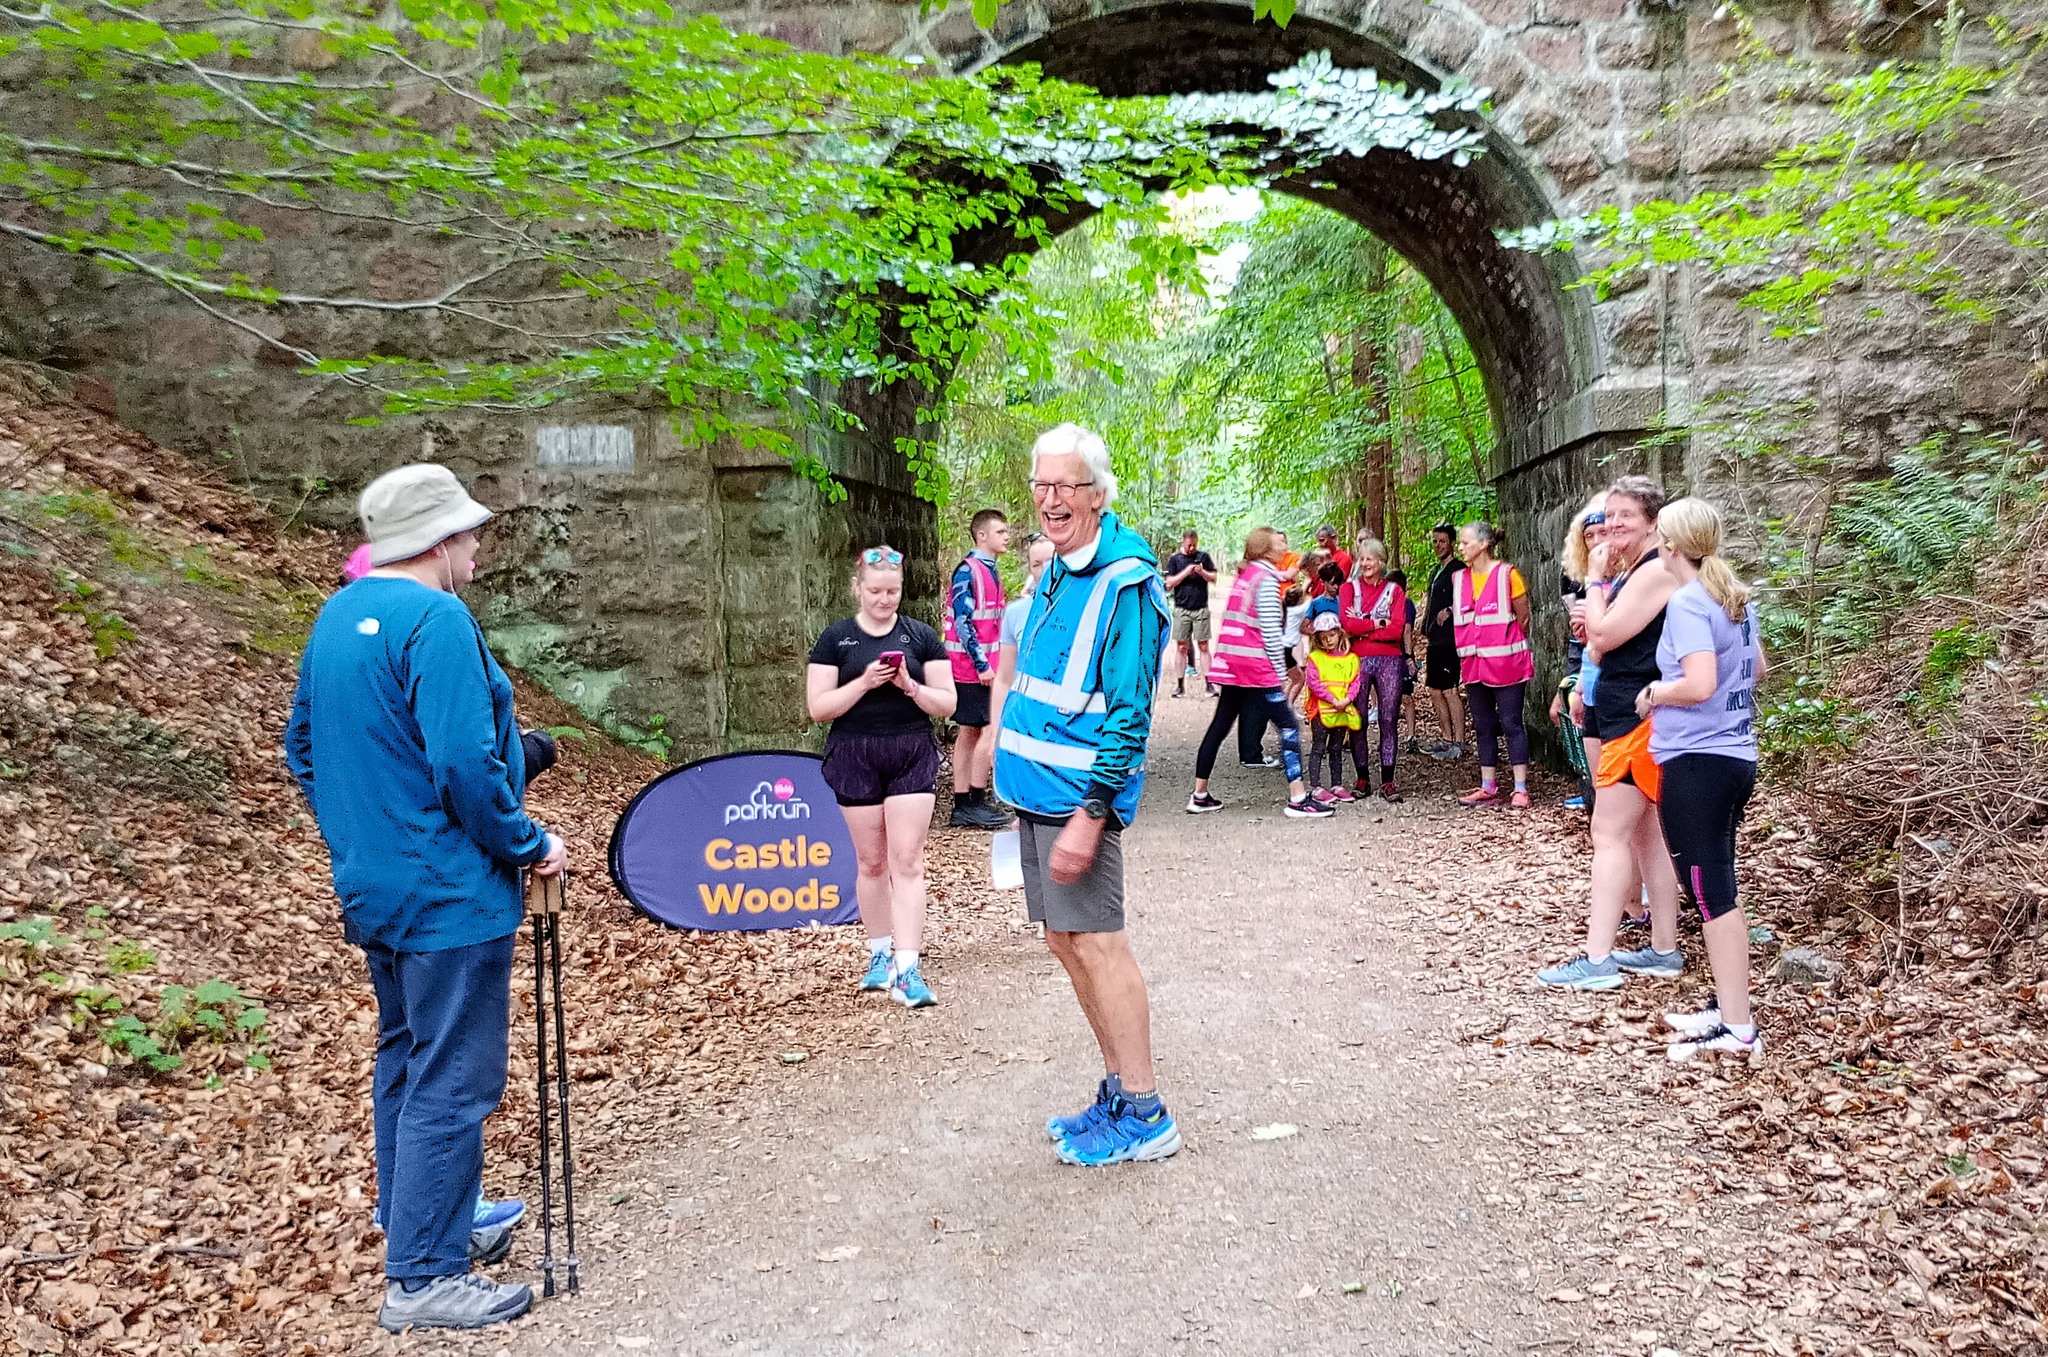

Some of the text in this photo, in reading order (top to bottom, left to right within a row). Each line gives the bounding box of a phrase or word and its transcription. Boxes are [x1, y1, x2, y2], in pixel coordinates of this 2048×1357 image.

[725, 791, 810, 825] parkrun
[705, 835, 832, 871] Castle
[698, 878, 840, 915] Woods
